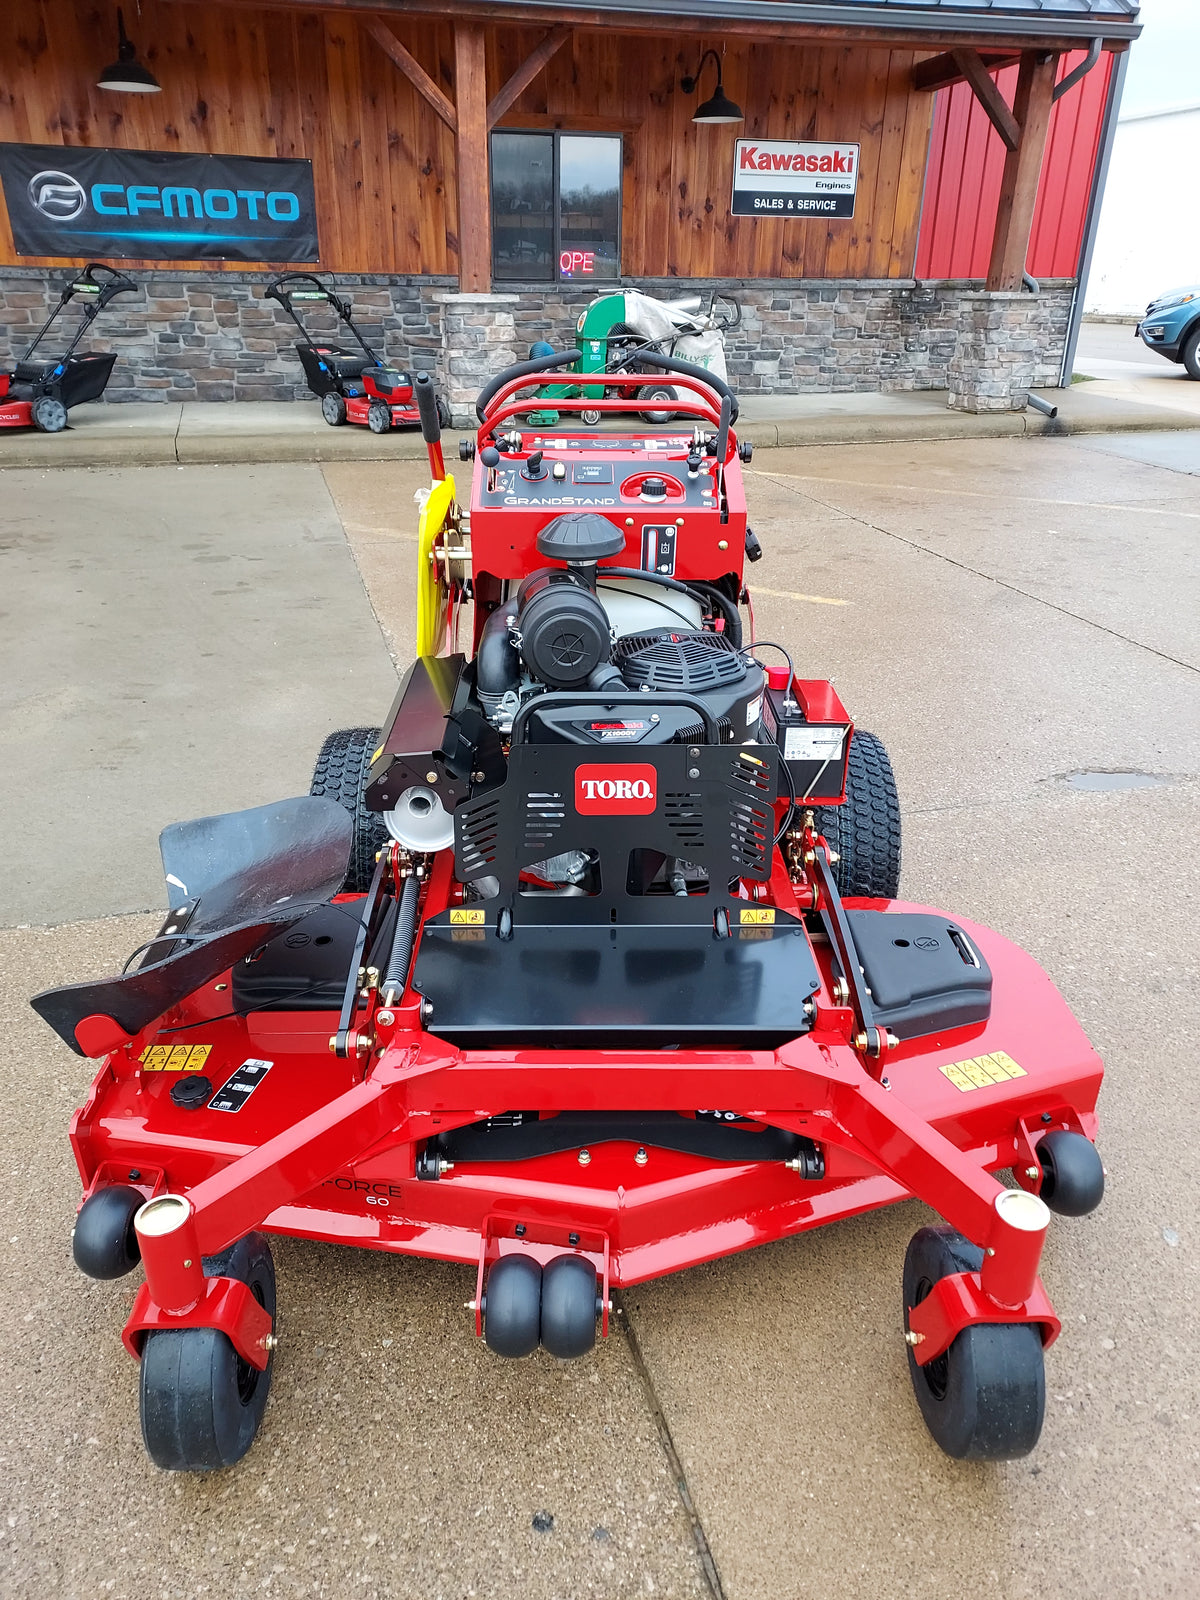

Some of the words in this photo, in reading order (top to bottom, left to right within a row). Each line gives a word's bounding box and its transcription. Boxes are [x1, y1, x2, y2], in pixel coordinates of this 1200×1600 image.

[740, 146, 854, 173] Kawasaki
[815, 181, 852, 190] Engines
[91, 184, 300, 221] CFMOTO
[754, 198, 784, 210] SALES
[787, 199, 794, 210] &
[797, 200, 837, 211] SERVICE
[675, 351, 700, 363] BILLY
[366, 1196, 389, 1206] 60
